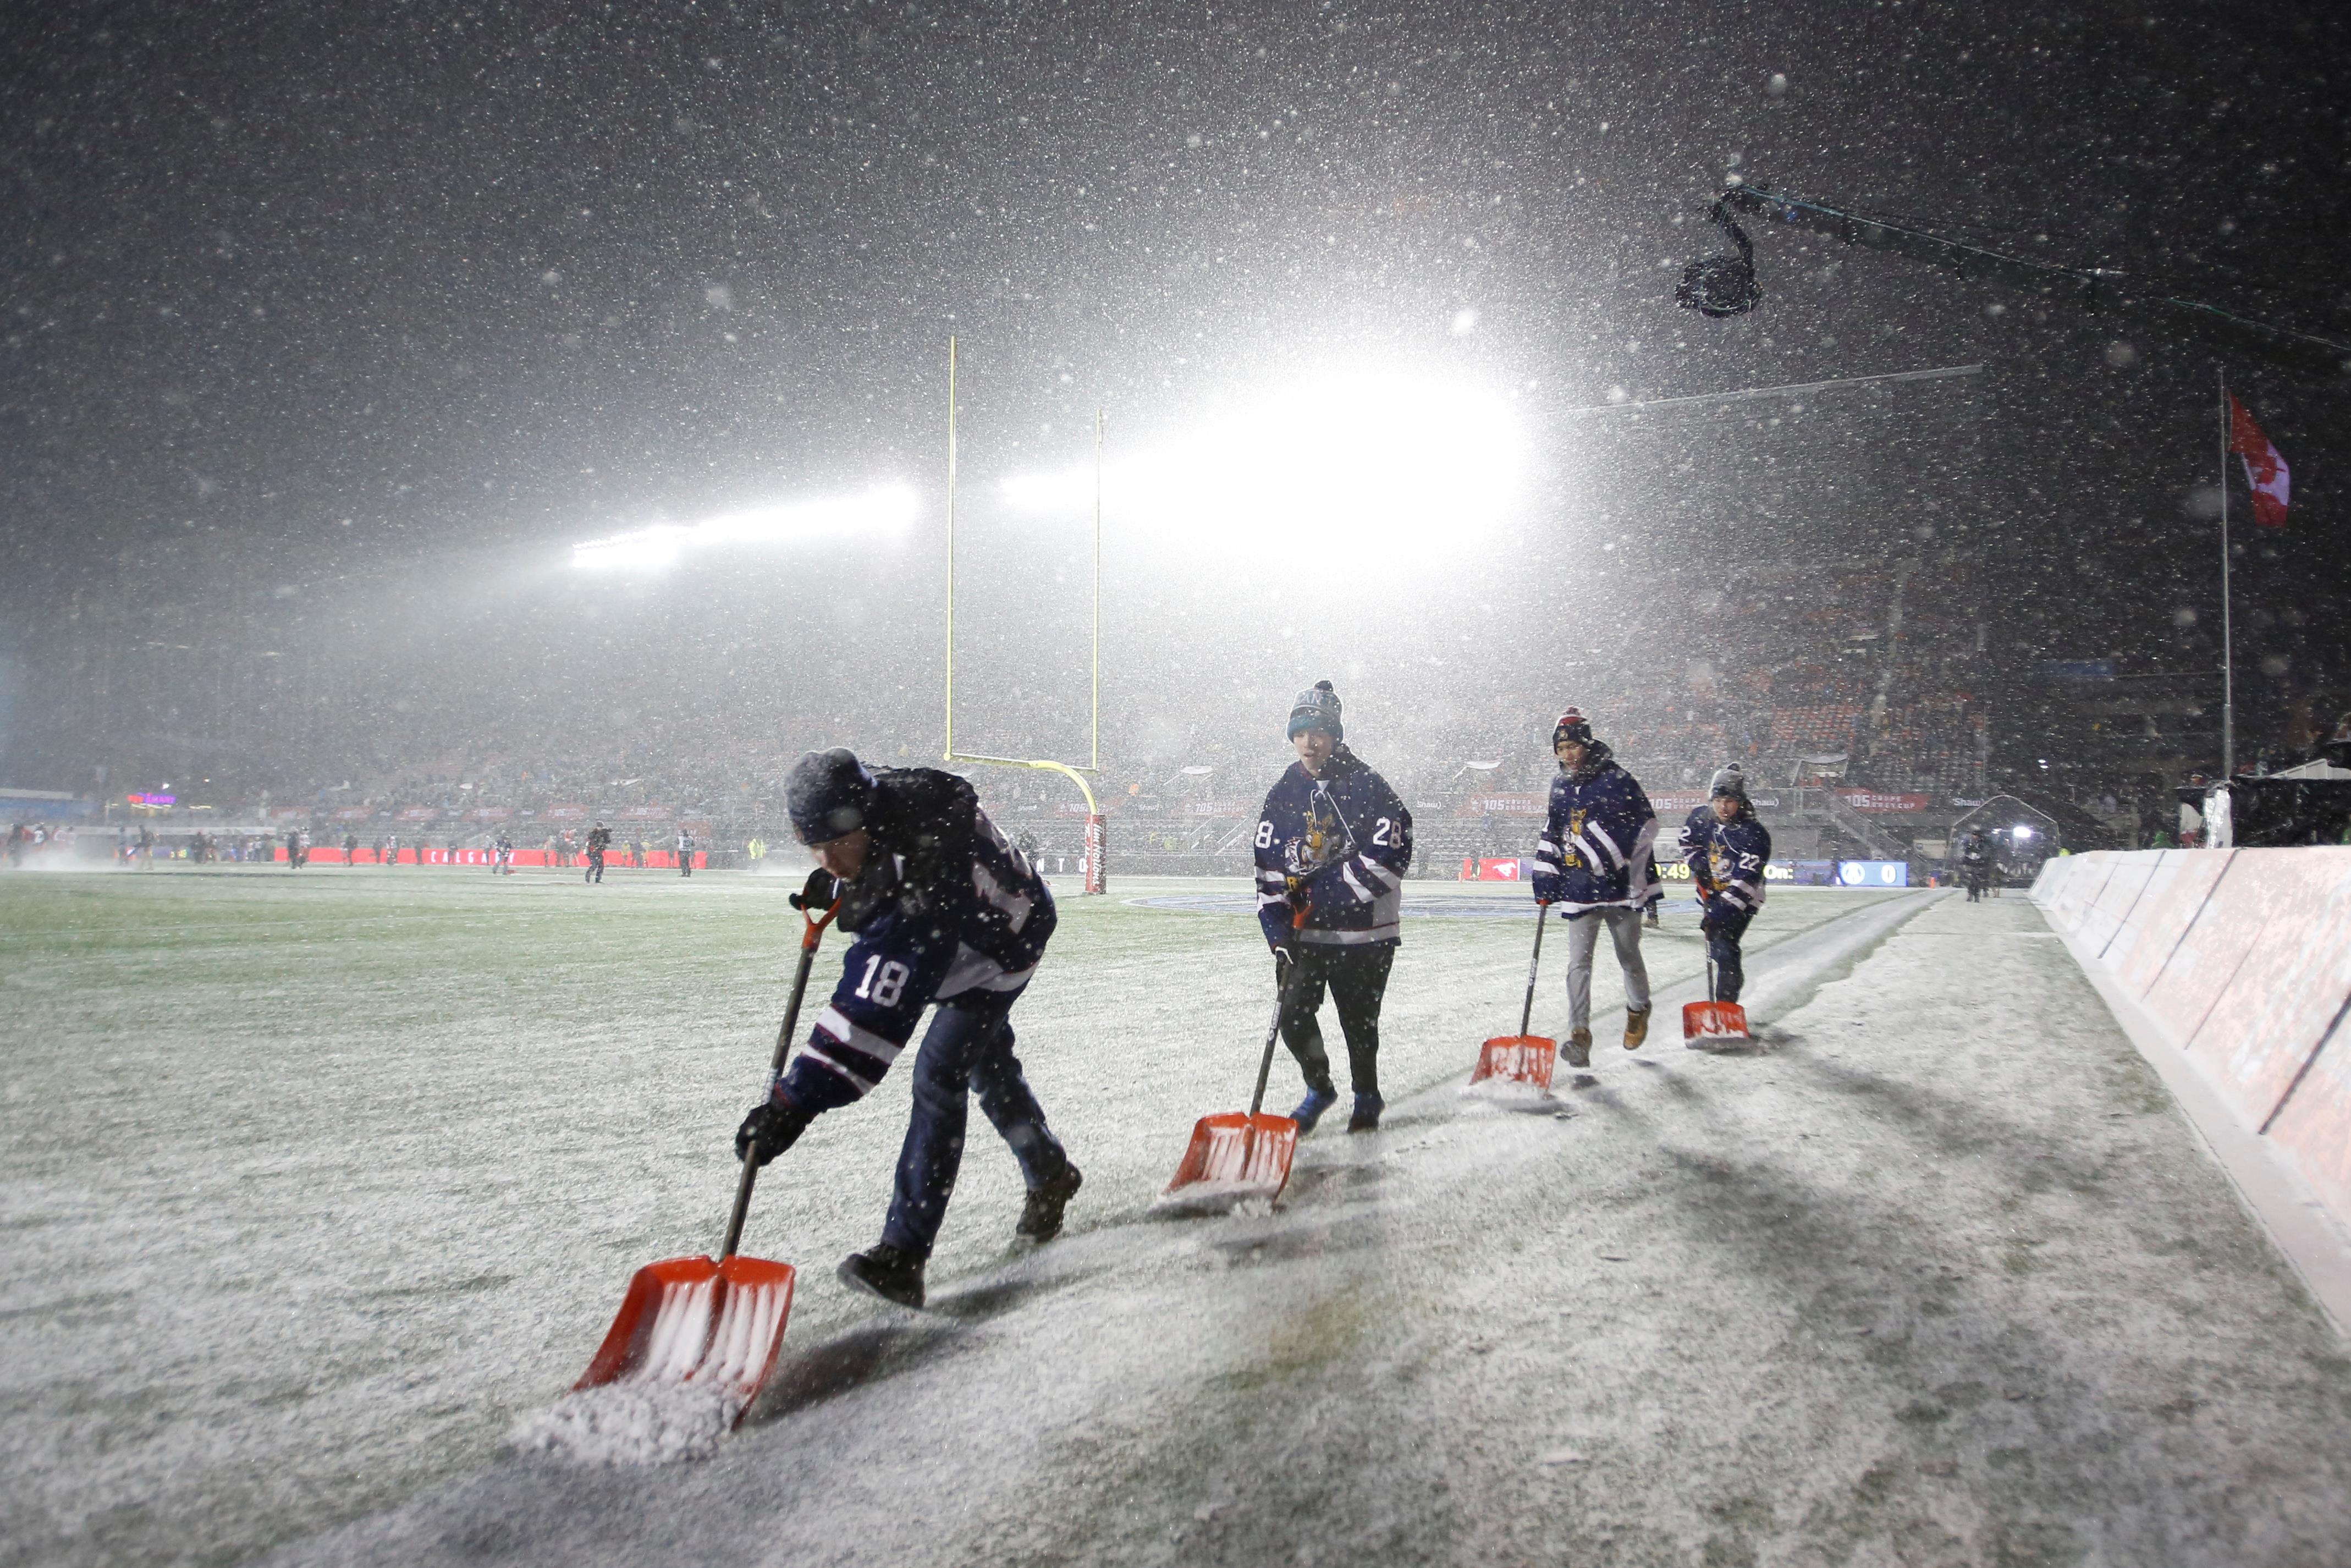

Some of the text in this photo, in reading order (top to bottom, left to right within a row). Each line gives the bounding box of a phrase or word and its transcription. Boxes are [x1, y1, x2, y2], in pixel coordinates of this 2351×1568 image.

[1484, 799, 1505, 810] 105
[1373, 818, 1402, 848] 28
[1739, 852, 1760, 873] 22
[1763, 865, 1793, 879] On:
[1881, 864, 1896, 884] 0
[855, 954, 910, 1008] 18
